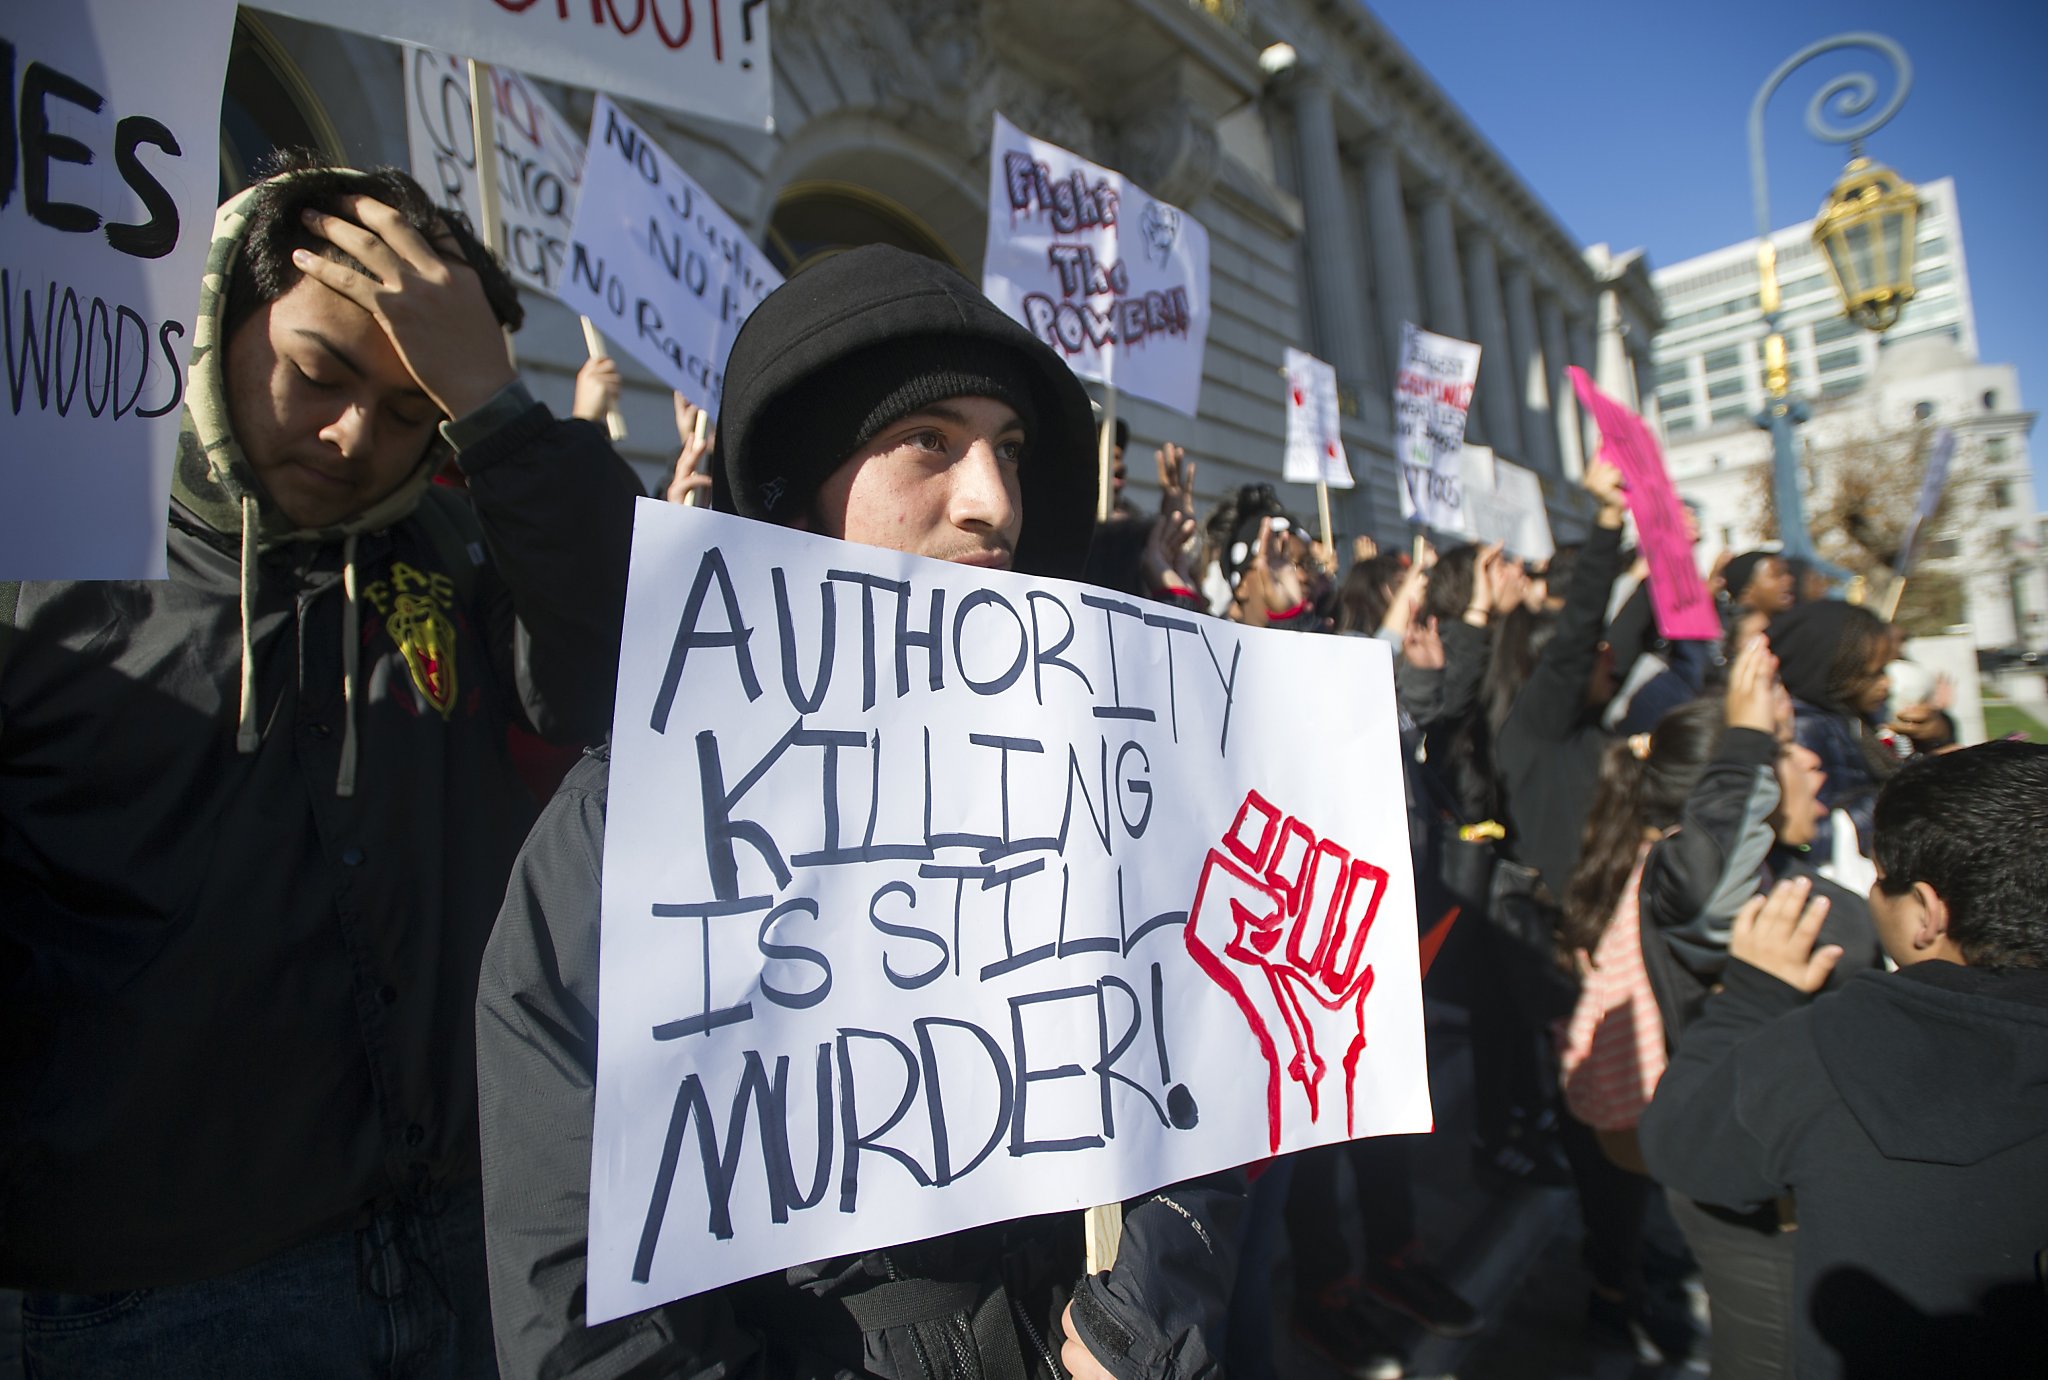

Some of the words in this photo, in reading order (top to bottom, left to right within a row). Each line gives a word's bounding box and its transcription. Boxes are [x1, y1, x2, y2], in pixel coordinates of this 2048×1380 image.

[0, 36, 182, 259] ES
[571, 241, 626, 318] NO
[648, 214, 708, 297] NO
[667, 184, 774, 302] Justic
[2, 268, 185, 421] WOODS
[649, 546, 1242, 757] AUTHORITY
[694, 713, 1153, 901] KILLING
[652, 893, 833, 1041] IS
[868, 857, 1189, 990] STILL
[632, 961, 1201, 1284] MURDER!
